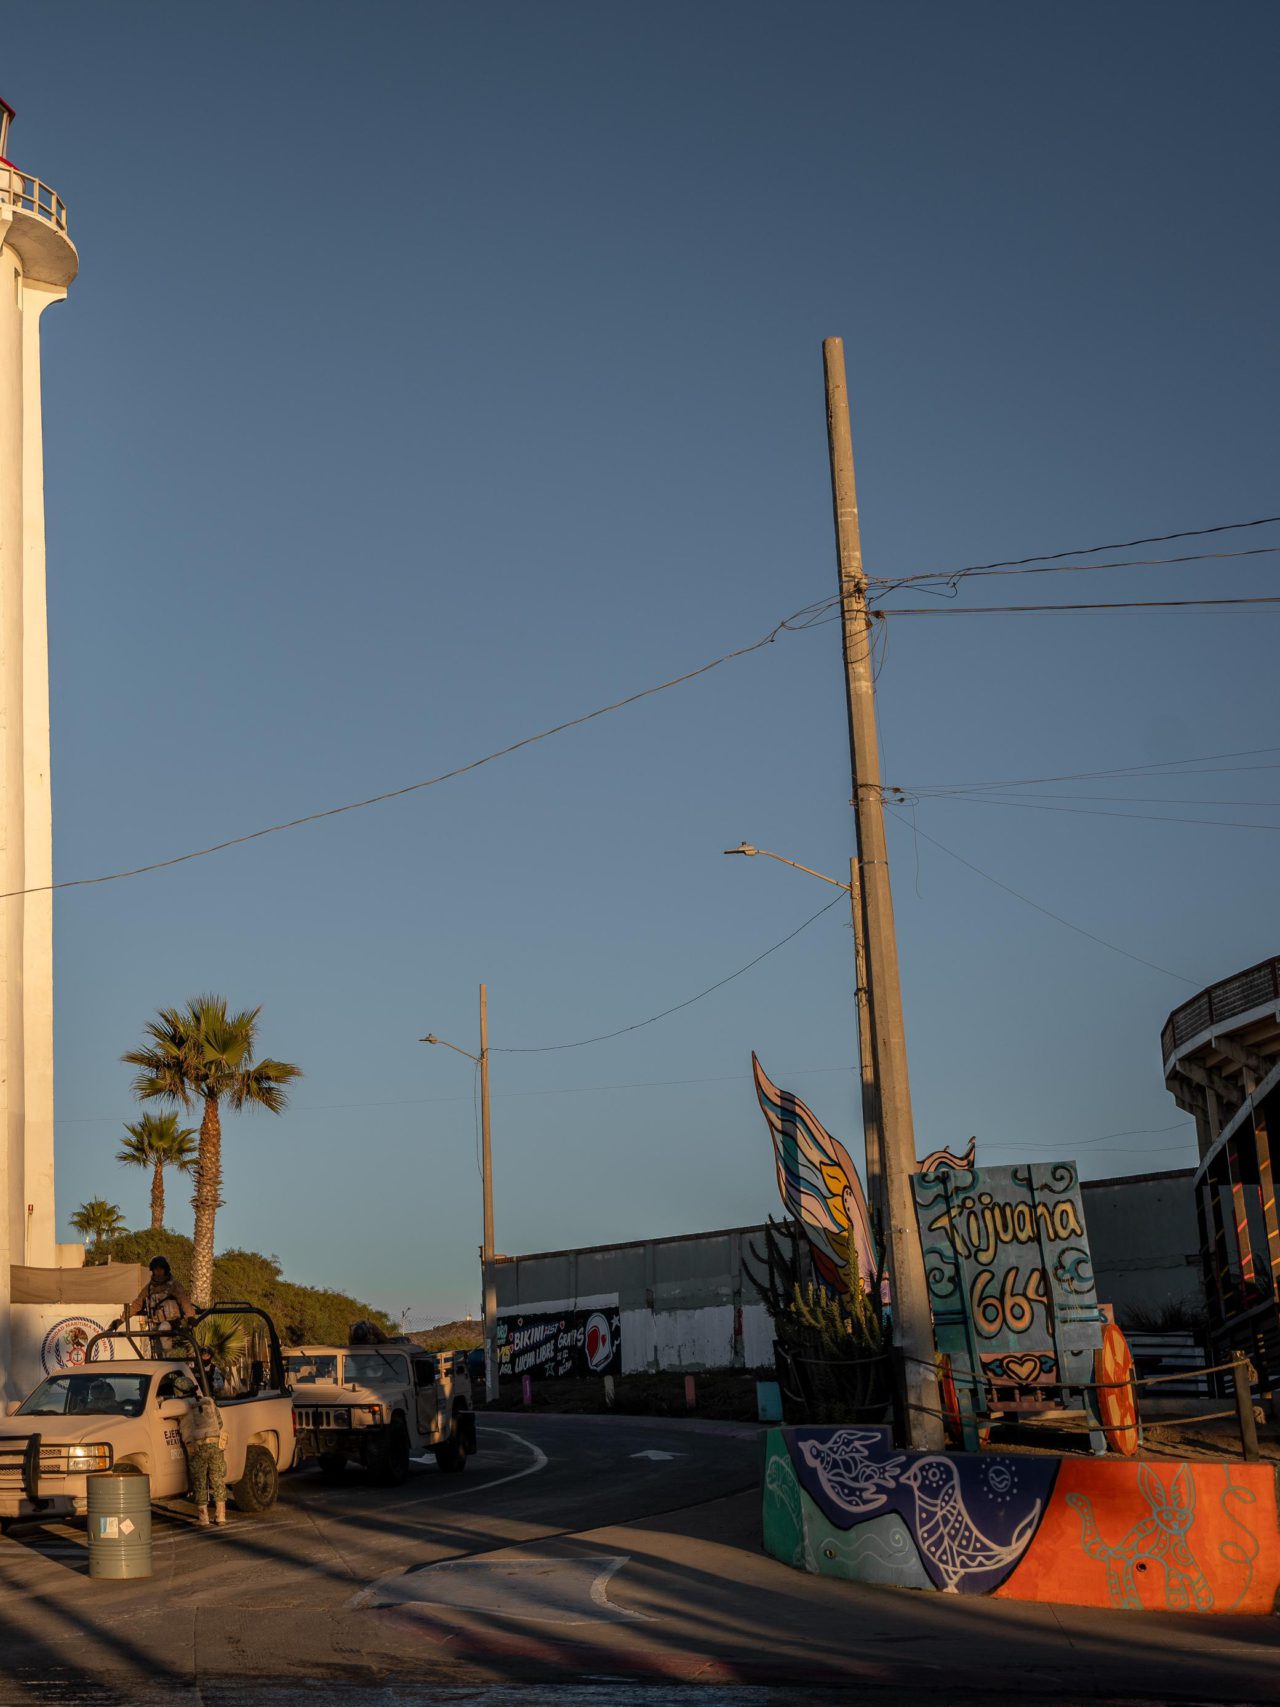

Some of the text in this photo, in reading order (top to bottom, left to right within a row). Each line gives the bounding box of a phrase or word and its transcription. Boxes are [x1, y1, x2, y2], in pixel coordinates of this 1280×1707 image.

[928, 1193, 1083, 1266] Tijuana
[970, 1267, 1055, 1339] 664
[46, 1326, 65, 1354] AUTORIDAD
[514, 1324, 545, 1350] BIKINI
[536, 1339, 555, 1364] LIBRE
